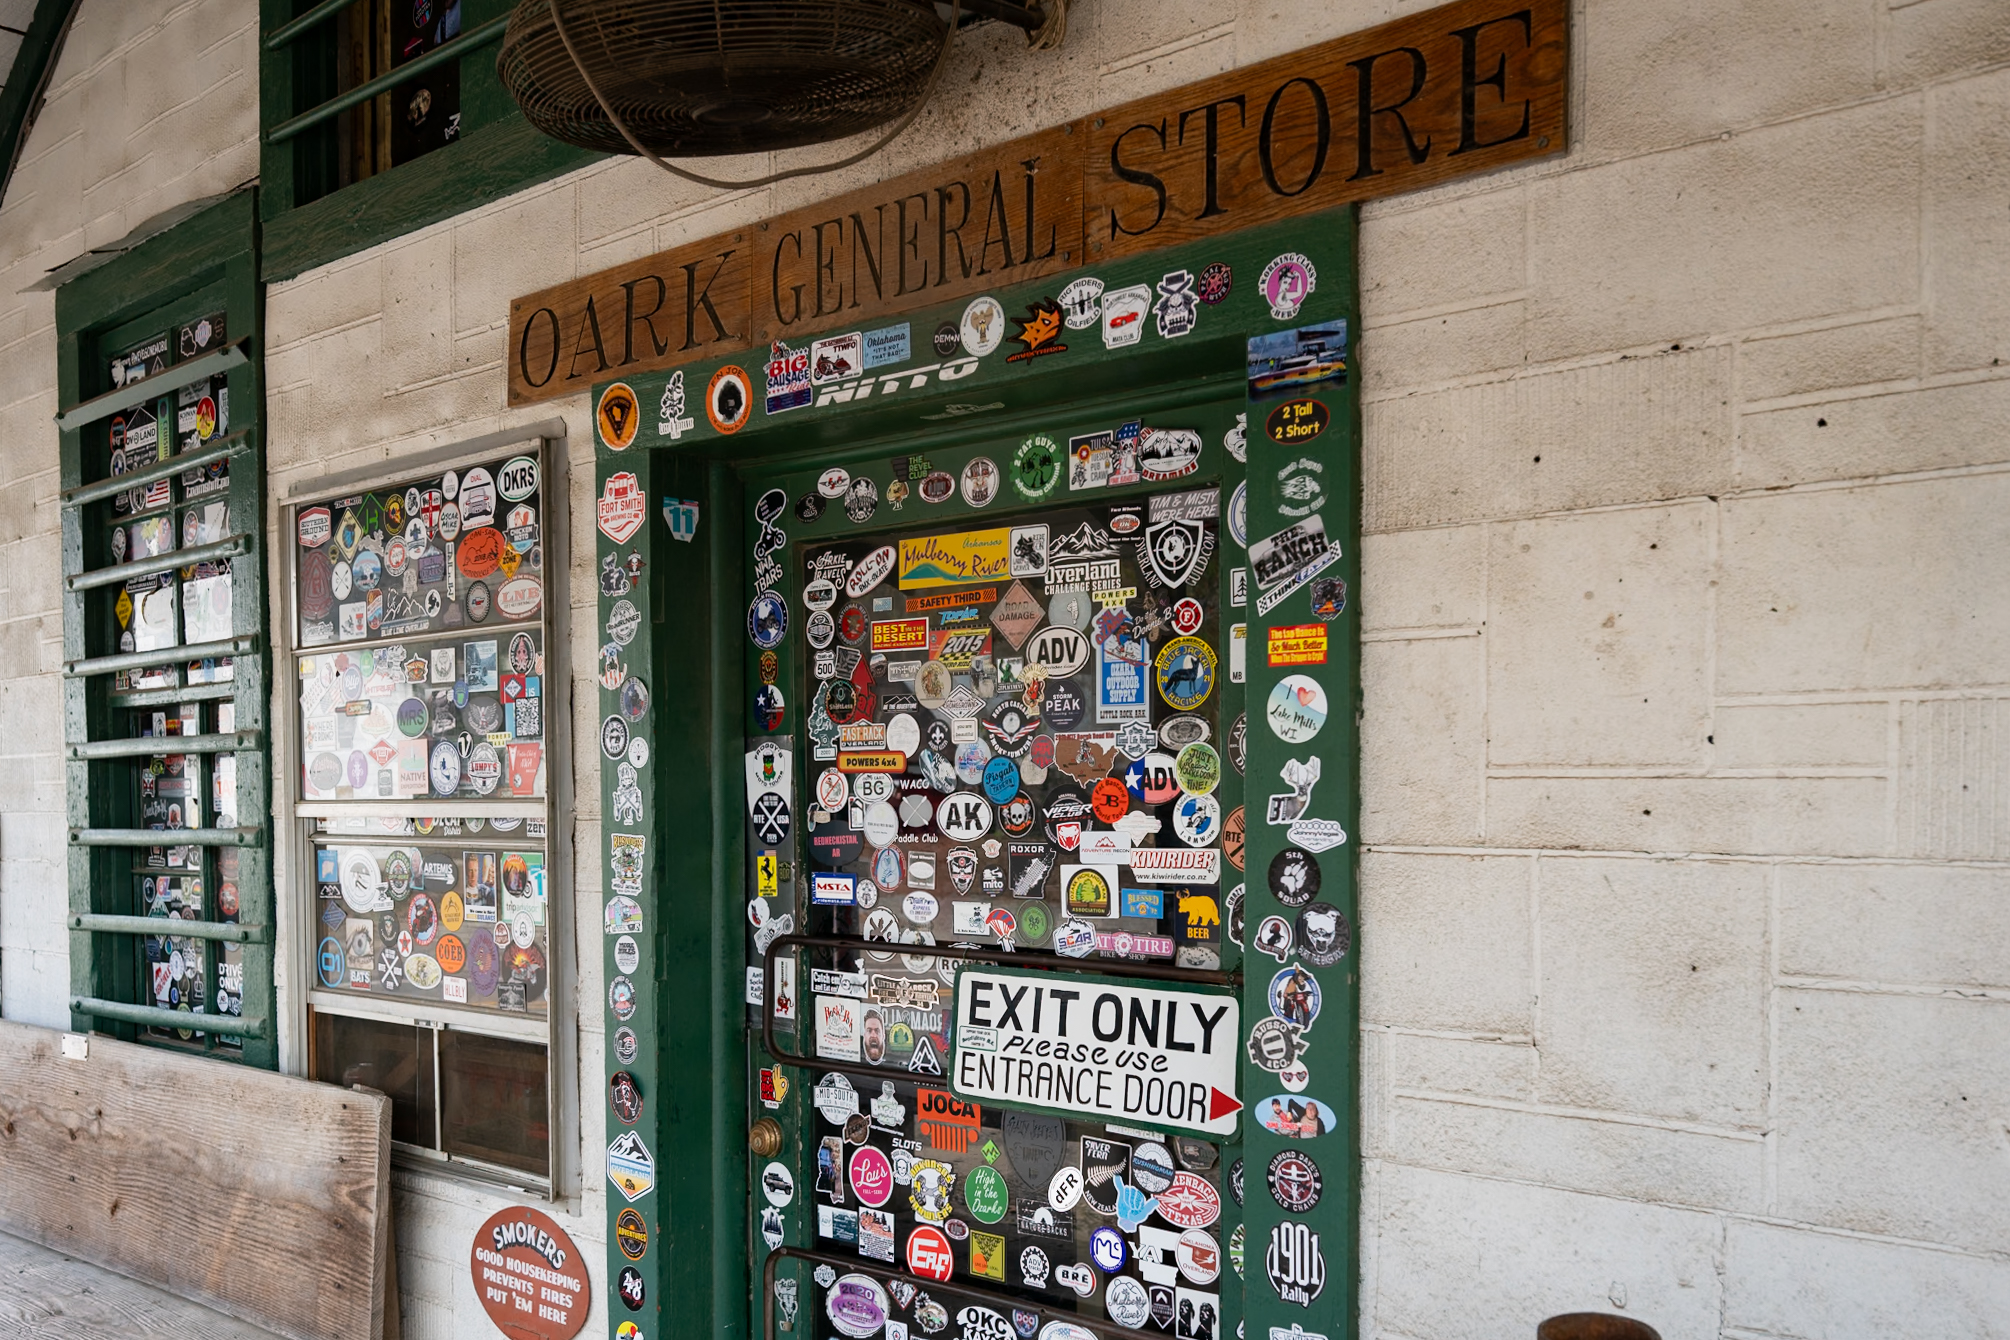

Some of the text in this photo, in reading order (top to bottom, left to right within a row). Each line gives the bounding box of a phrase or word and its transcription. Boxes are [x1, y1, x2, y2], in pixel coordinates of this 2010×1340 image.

[519, 10, 1532, 389] OARK GENERAL STORE
[1260, 254, 1316, 285] WORKING CLASS
[1059, 279, 1102, 302] RIG RIDERS
[1067, 310, 1100, 328] OILFIELD
[1274, 308, 1298, 318] HERO
[867, 333, 906, 348] Oklahoma
[726, 367, 743, 378] JOE
[769, 355, 808, 377] BIG
[767, 369, 809, 389] SAUSAGE
[1282, 402, 1313, 418] 2 Tall
[1275, 422, 1320, 439] 2 Short
[1018, 440, 1032, 460] FAT
[1035, 436, 1057, 454] GUYS
[909, 456, 923, 464] THE
[909, 462, 932, 472] REVEL
[470, 474, 482, 484] DIAL
[909, 471, 928, 480] CLUB
[1014, 462, 1060, 496] adventure channel
[1142, 462, 1197, 480] DREAMERS
[504, 466, 535, 493] DKRS
[601, 497, 642, 514] FORT SMITH
[1150, 490, 1218, 509] TIM & MISTY
[440, 511, 459, 522] OSCAR
[1152, 504, 1218, 522] WERE HERE
[300, 524, 328, 536] GROUND
[442, 519, 458, 529] MIKE
[510, 526, 533, 537] CHICKEN
[962, 534, 1002, 548] Arkansas
[502, 554, 516, 566] ZONE
[1185, 530, 1215, 586] GUILD.COM
[1254, 532, 1328, 584] RANCH
[849, 548, 890, 592] ROLL-ON
[1044, 559, 1121, 584] Overland
[754, 564, 784, 597] TBARS
[858, 564, 889, 594] BMX-SKATE
[502, 586, 540, 604] LNB
[1044, 579, 1121, 596] CHALLENGE SERIES
[1094, 589, 1135, 600] POWERS
[1267, 578, 1300, 604] THINK
[920, 592, 982, 609] SAFETY THIRD
[1005, 601, 1030, 612] ROAD
[998, 610, 1036, 622] DAMAGE
[381, 626, 392, 637] BLUE
[404, 620, 430, 633] OVERLAND
[874, 624, 907, 634] BEST
[874, 632, 925, 644] DESERT
[942, 634, 986, 653] 2015
[1037, 636, 1080, 664] ADV
[1163, 646, 1210, 671] BLUE JACKAL
[818, 663, 833, 675] 500
[1106, 676, 1140, 690] OUTDOOR
[1110, 689, 1137, 703] SUPPLY
[1168, 692, 1202, 706] RACING
[992, 701, 1010, 718] NORTH
[1046, 699, 1080, 712] PEAK
[400, 708, 424, 726] MRS
[1270, 704, 1317, 731] Lake Mills
[842, 726, 884, 741] FAST RACK
[1280, 725, 1297, 740] WI
[754, 742, 784, 760] FROGGY'S
[1190, 748, 1213, 764] JUST
[470, 762, 498, 772] LUMPY'S
[846, 758, 897, 767] POWERS 4x4
[400, 772, 426, 782] NATIVE
[986, 762, 1014, 785] Pisgah
[1140, 766, 1178, 791] ADV
[863, 780, 884, 796] BG
[900, 778, 930, 790] WACO
[776, 814, 790, 824] USA
[946, 802, 984, 830] AK
[1042, 804, 1093, 818] VIPER
[894, 834, 938, 843] Paddle Club
[832, 848, 840, 858] AR
[1130, 850, 1215, 869] KIWIRIDER
[424, 862, 453, 874] ARTEMIS
[982, 880, 1004, 888] mito
[1136, 872, 1207, 881] www.kiwirider.co.nz
[816, 883, 850, 892] MSTA
[1128, 894, 1158, 904] BLESSED
[1277, 890, 1310, 904] SQUAD
[1058, 932, 1092, 946] SCAR
[1187, 927, 1210, 940] BEER
[1096, 935, 1170, 954] AT TIRE
[1100, 950, 1116, 958] BIKE
[1128, 952, 1146, 960] SHOP
[913, 984, 932, 992] ROCK
[968, 980, 1229, 1054] EXIT ONLY
[1256, 1020, 1288, 1040] RUSSO
[1115, 1050, 1169, 1073] use
[819, 1089, 854, 1100] MID-SOUTH
[960, 1051, 1207, 1124] ENTRANCE DOOR
[922, 1093, 976, 1118] JOCA
[892, 1138, 922, 1152] SLOTS
[1084, 1140, 1111, 1152] SILVER
[1087, 1149, 1109, 1160] FERN
[612, 1164, 650, 1180] OVERLAND
[910, 1159, 954, 1184] ARKANSAS
[1269, 1151, 1320, 1178] DIAMOND DAVE'S
[854, 1158, 888, 1188] Lou's
[975, 1169, 996, 1190] High
[974, 1186, 998, 1199] in the
[1055, 1174, 1079, 1204] dFR
[908, 1195, 953, 1220] CRAWLERS
[972, 1198, 1003, 1215] Ozarks
[1271, 1187, 1319, 1212] GOLD CHAINS
[1167, 1210, 1204, 1226] TEXAS
[618, 1227, 646, 1244] ADVENTURES
[1182, 1236, 1216, 1250] OKLAHOMA
[493, 1220, 567, 1270] SMOKERS
[1028, 1258, 1042, 1266] ADV
[1271, 1221, 1320, 1287] 1901
[476, 1247, 581, 1292] GOOD HOUSEKEEPING
[1062, 1270, 1089, 1284] BRE
[1182, 1262, 1214, 1276] OVERLAND
[483, 1268, 573, 1309] PREVENTS FIRES
[842, 1284, 874, 1300] 2020
[1281, 1284, 1310, 1307] Rally
[487, 1286, 508, 1304] PUT
[539, 1305, 568, 1326] HERE
[966, 1308, 1007, 1334] OKC
